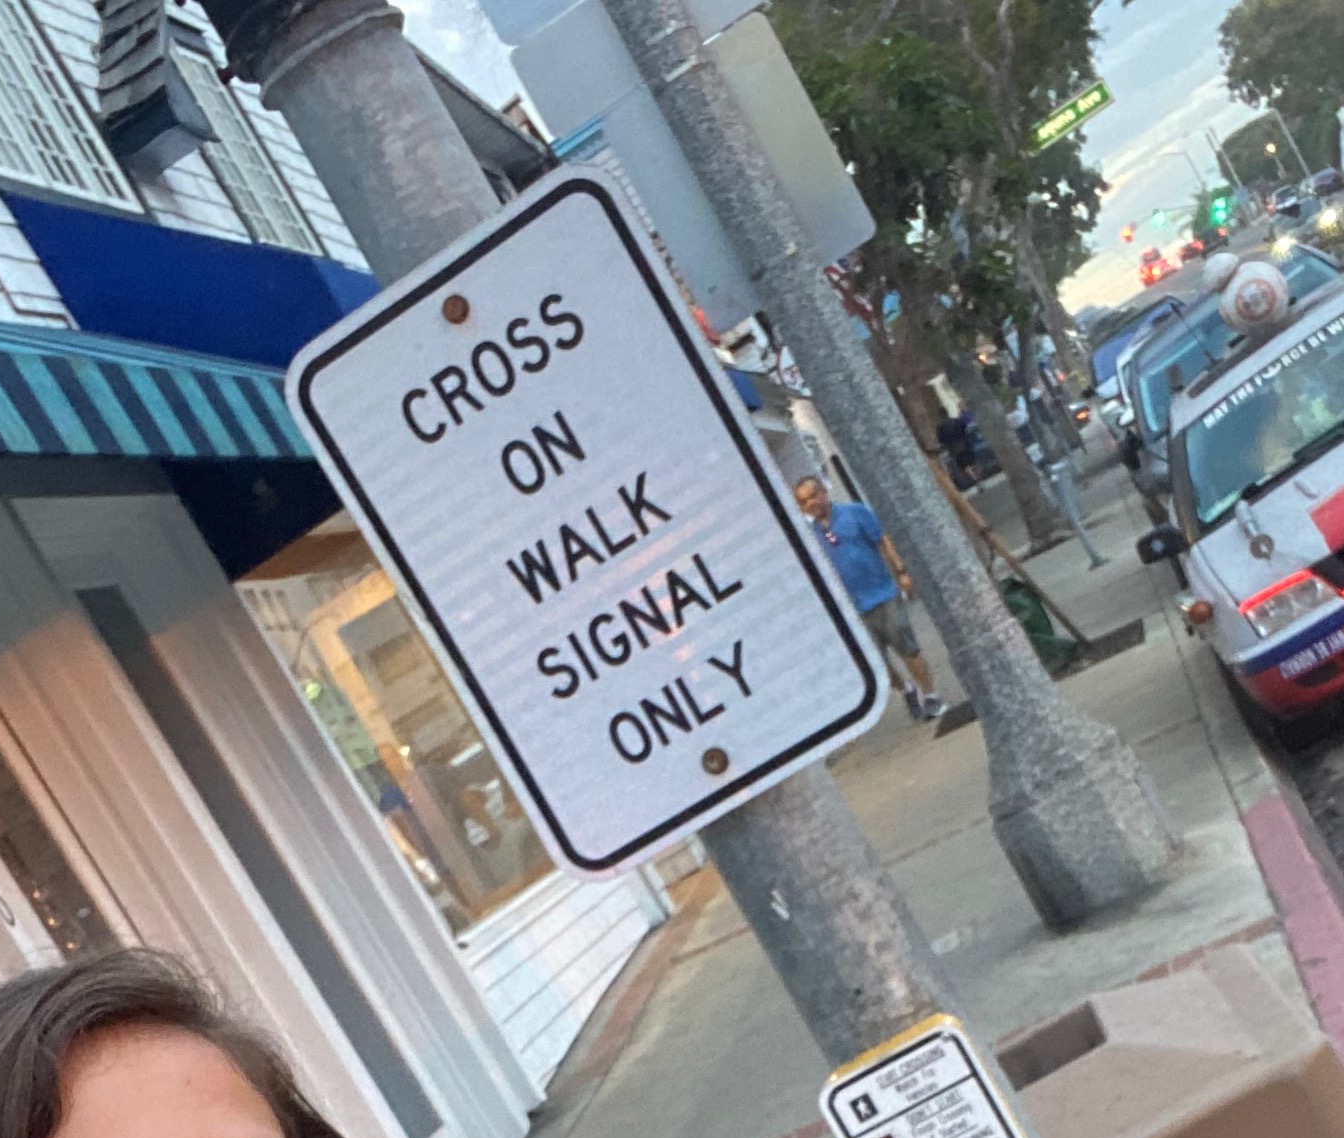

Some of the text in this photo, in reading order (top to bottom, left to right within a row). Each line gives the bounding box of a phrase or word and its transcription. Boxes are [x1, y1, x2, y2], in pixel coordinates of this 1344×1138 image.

[401, 292, 585, 443] CROSS
[1228, 382, 1255, 405] THE
[501, 411, 588, 496] ON
[507, 470, 673, 605] WALK
[537, 553, 743, 700] SIGNAL
[609, 641, 754, 765] ONLY
